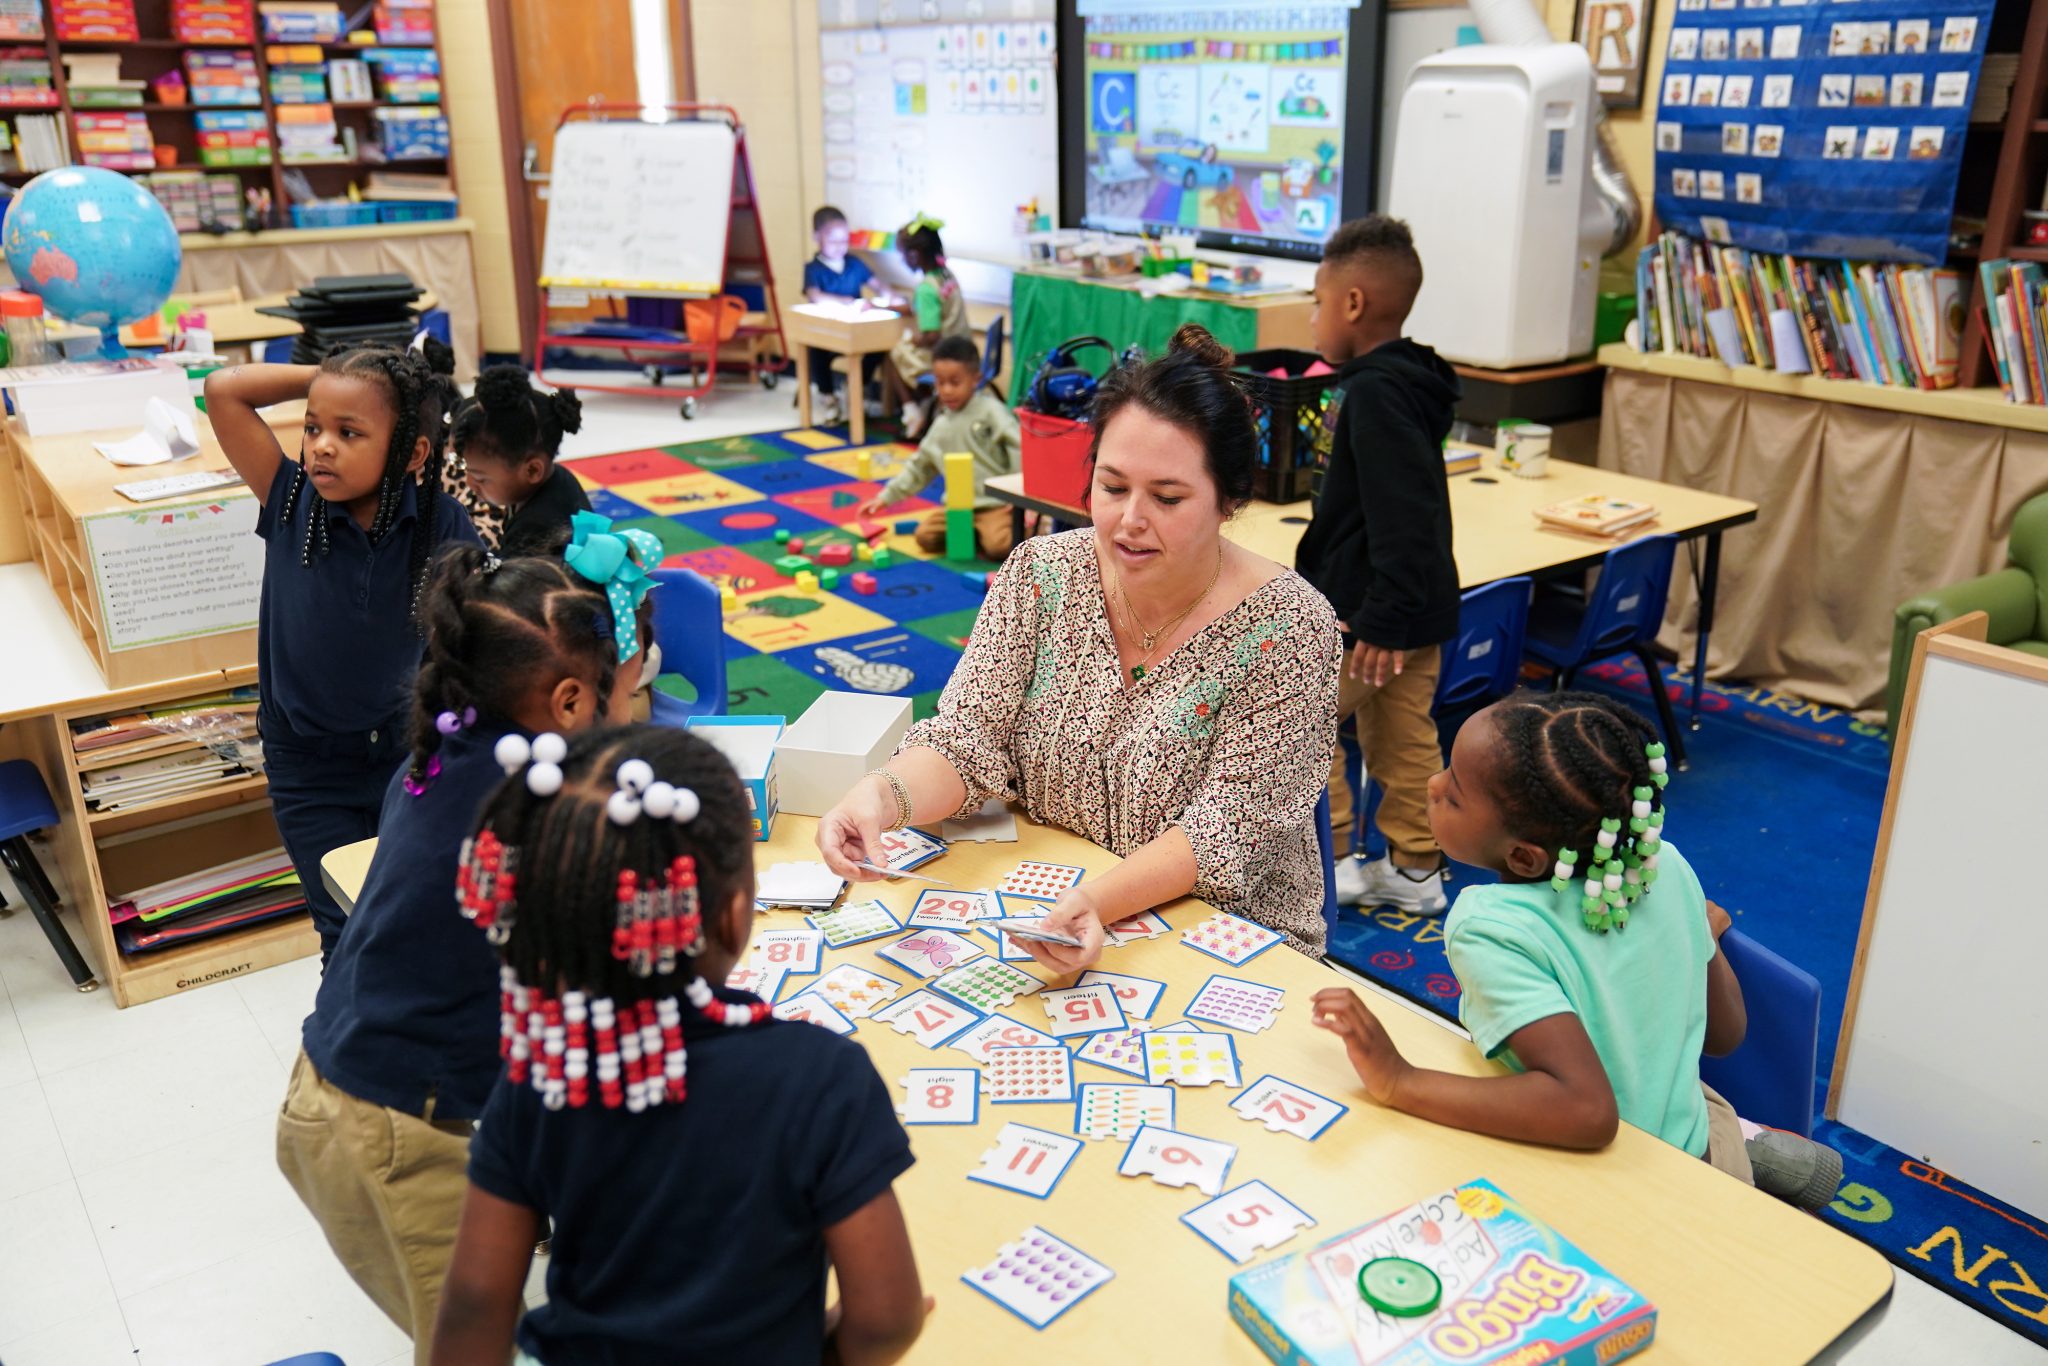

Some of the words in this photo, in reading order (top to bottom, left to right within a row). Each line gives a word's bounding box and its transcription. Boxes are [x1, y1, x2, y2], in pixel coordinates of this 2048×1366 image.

[1587, 3, 1634, 65] R
[1100, 78, 1125, 126] C
[147, 544, 161, 552] you
[195, 535, 212, 543] what
[215, 534, 228, 542] you
[124, 560, 138, 569] you
[166, 551, 185, 560] about
[126, 569, 140, 578] you
[167, 561, 186, 570] about
[143, 578, 157, 586] you
[144, 587, 158, 595] you
[133, 599, 146, 607] you
[173, 590, 190, 598] what
[212, 603, 226, 612] you
[919, 898, 970, 917] 29
[767, 942, 806, 962] 18
[176, 962, 253, 988] CHILDCRAFT
[1064, 991, 1098, 1000] fifteen
[914, 1003, 954, 1031] 17
[1065, 998, 1106, 1022] 15
[977, 1027, 1001, 1042] thirty
[928, 1076, 955, 1084] eight
[926, 1085, 954, 1108] 8
[1263, 1093, 1316, 1122] 12
[1022, 1137, 1058, 1150] eleven
[1007, 1146, 1047, 1175] 11
[1161, 1146, 1203, 1166] 6
[1226, 1203, 1273, 1227] 5
[1434, 1256, 1580, 1358] Bingo
